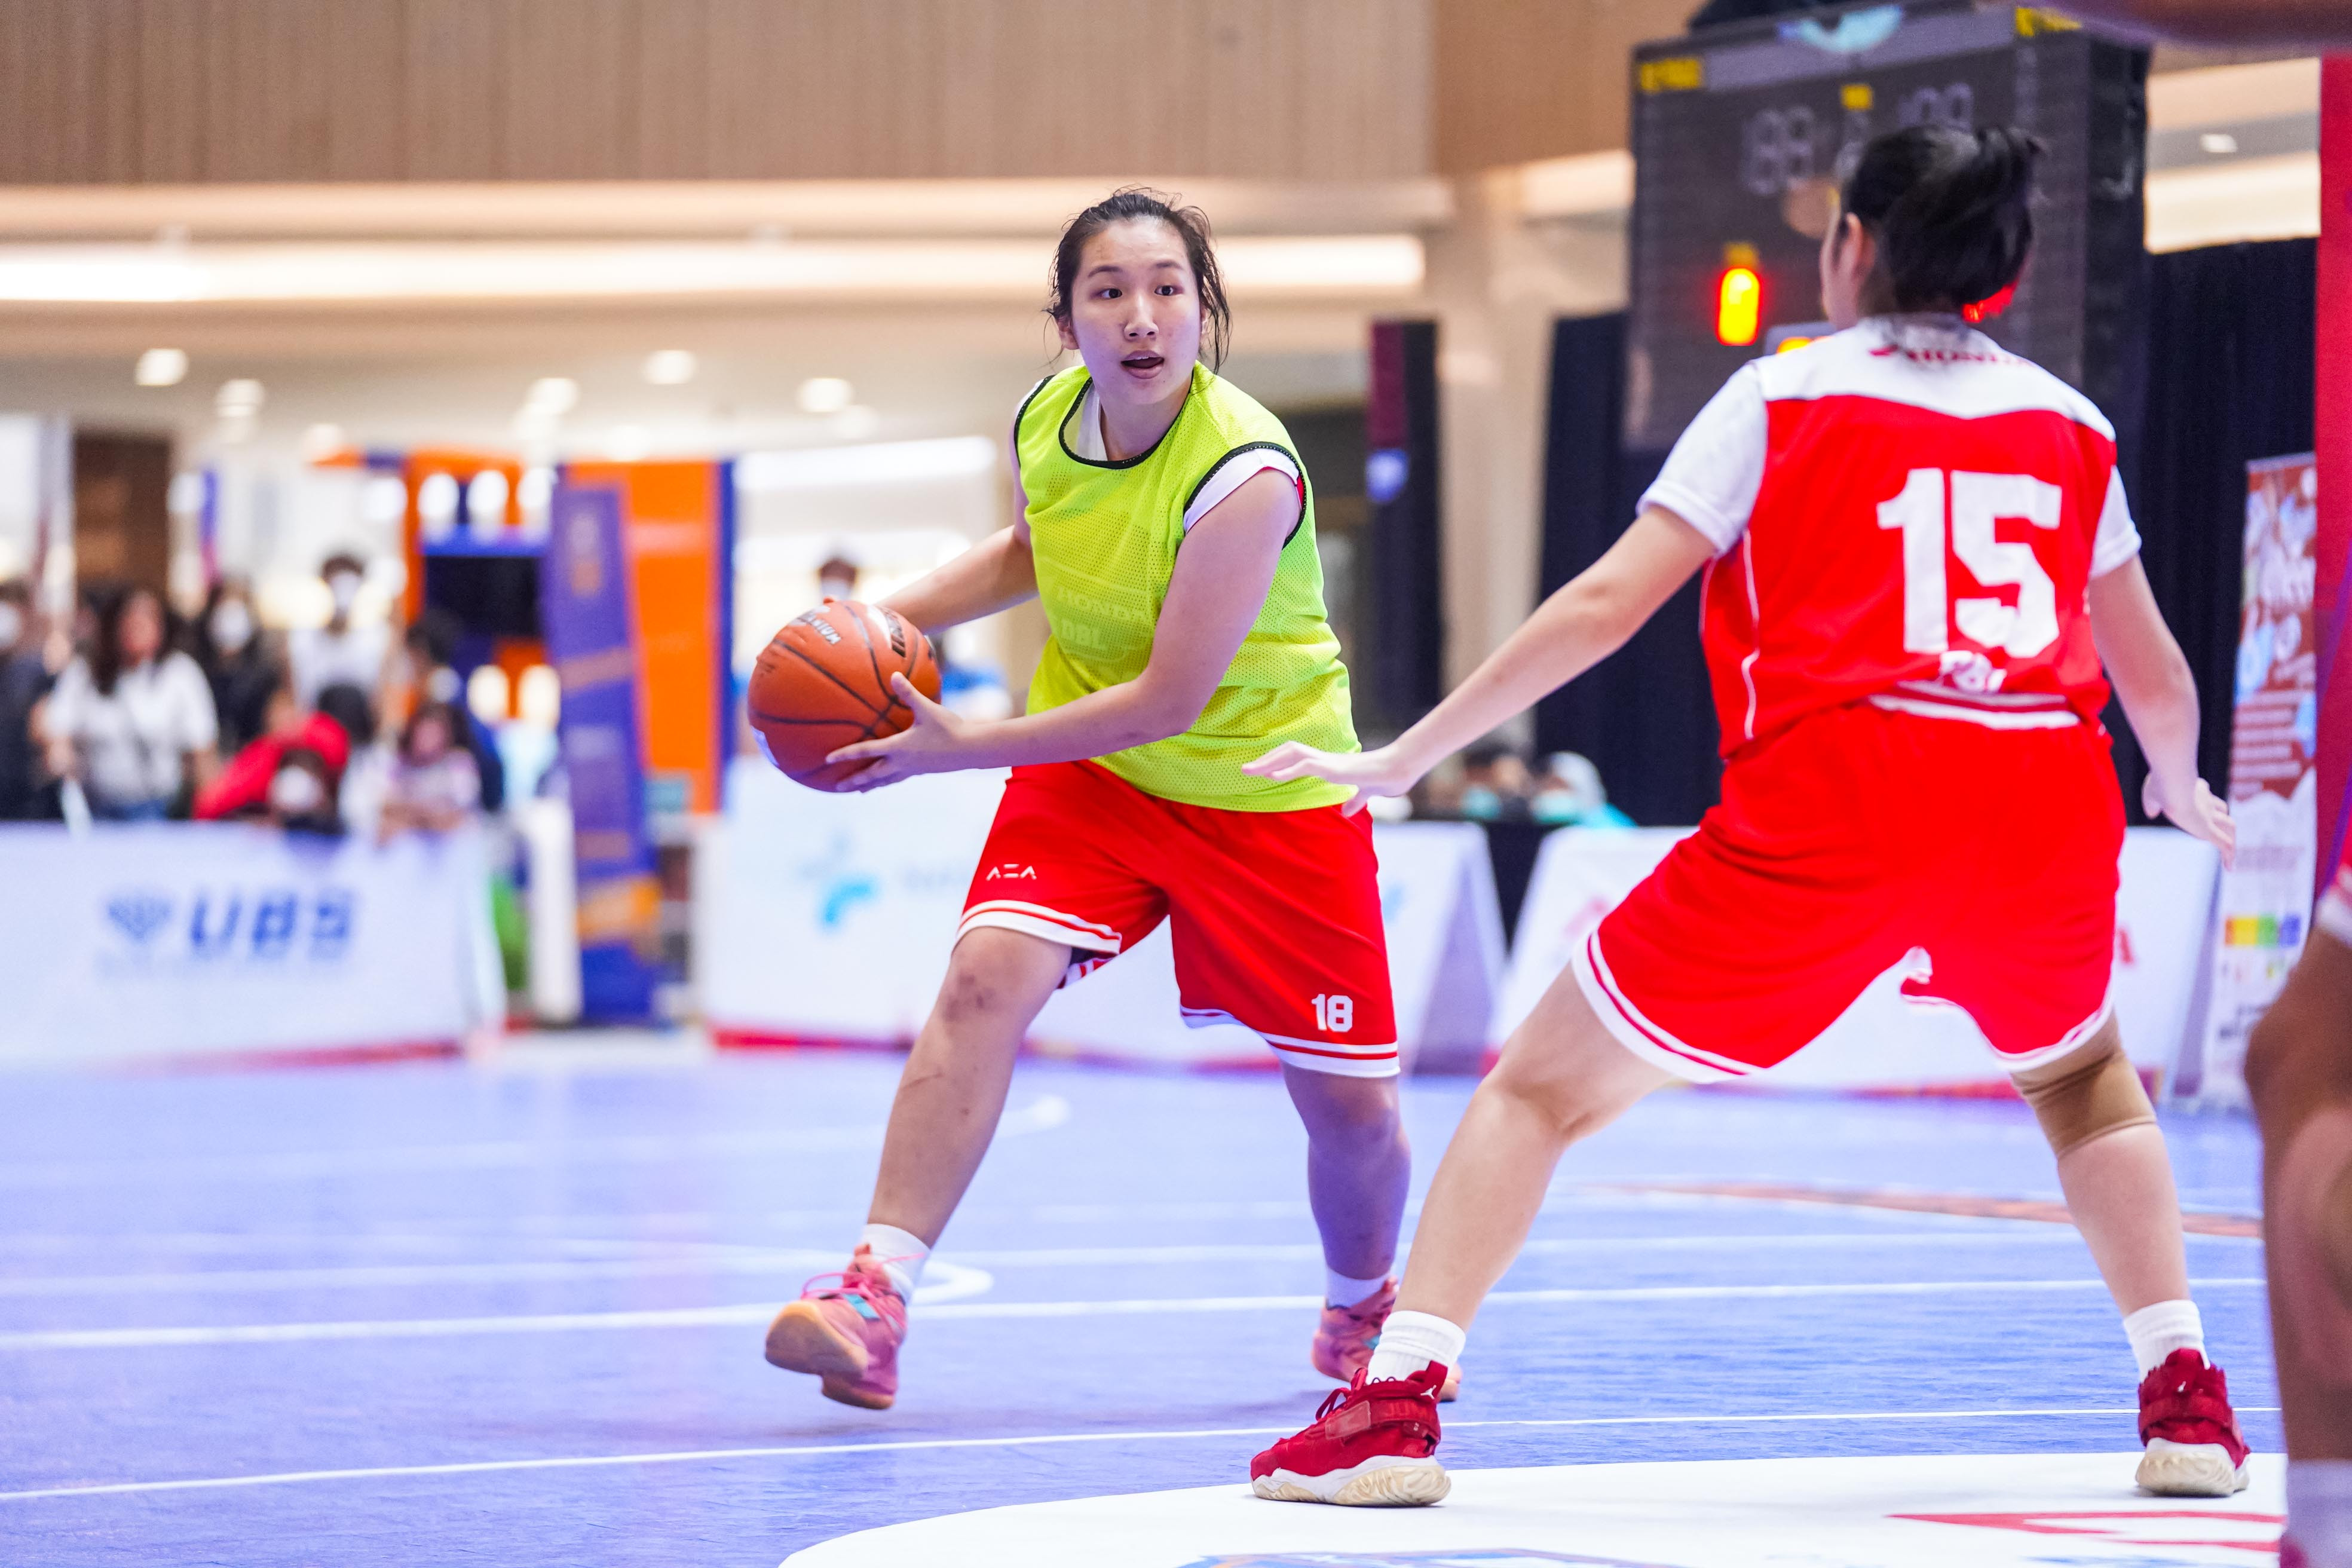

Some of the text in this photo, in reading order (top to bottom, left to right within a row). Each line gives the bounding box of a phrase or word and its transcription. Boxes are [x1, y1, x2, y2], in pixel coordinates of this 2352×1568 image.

[1876, 467, 2062, 659] 15
[1056, 585, 1149, 623] HONDA
[1311, 993, 1353, 1033] 18
